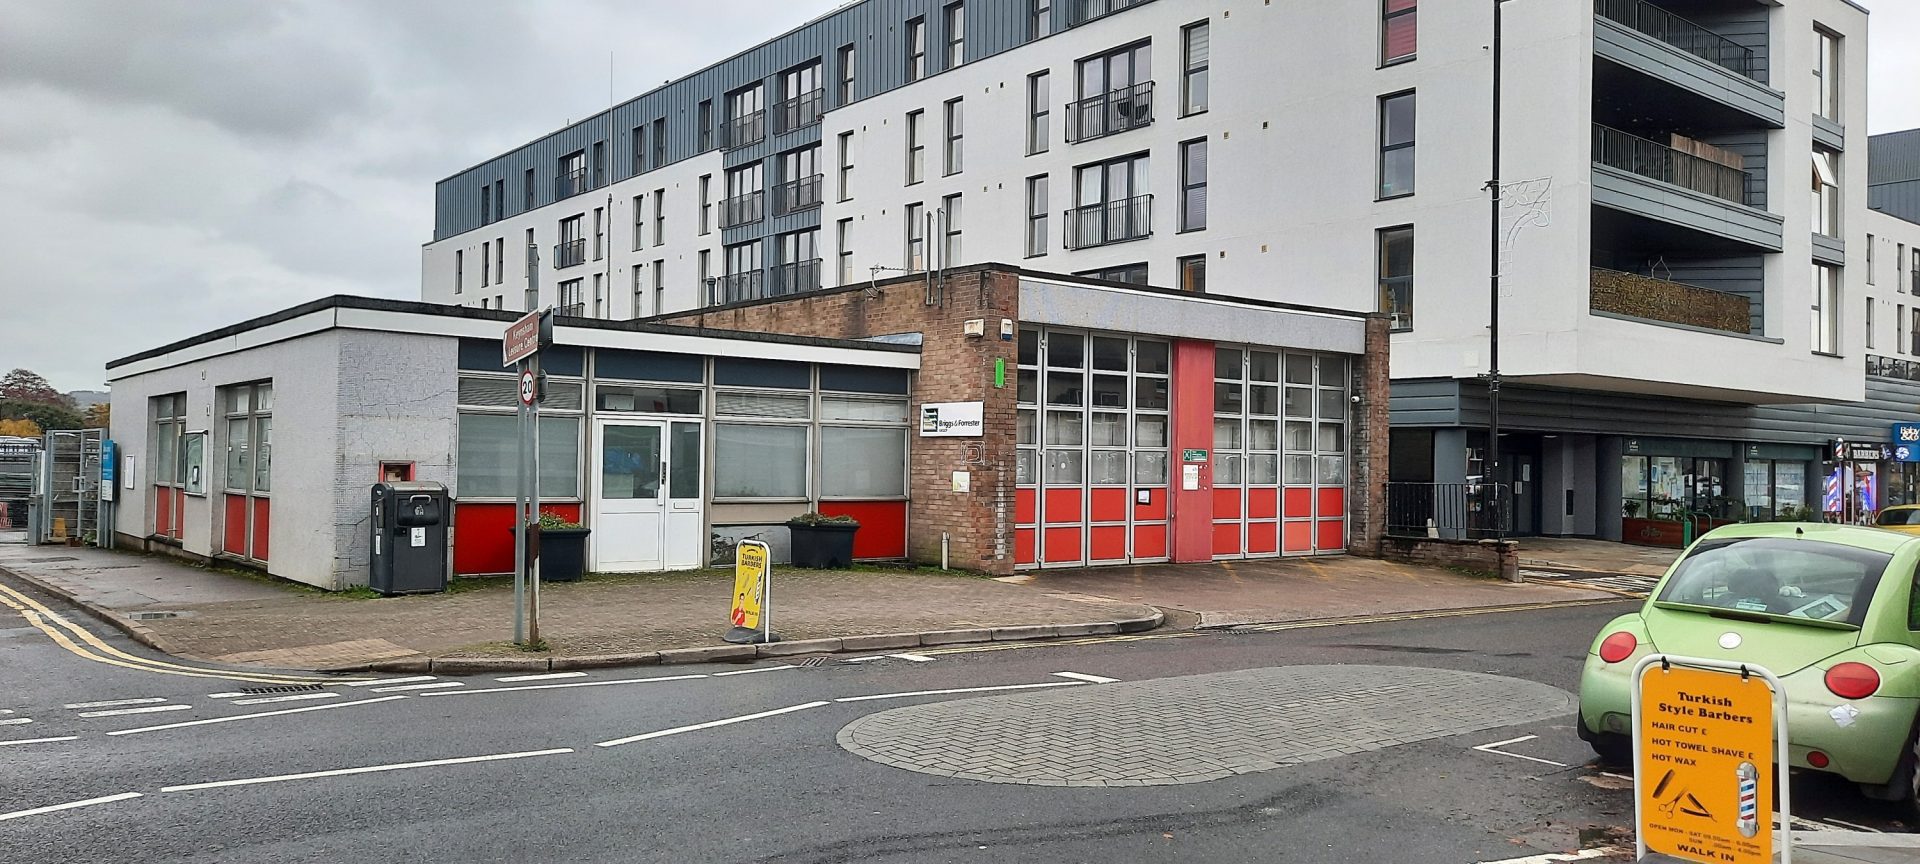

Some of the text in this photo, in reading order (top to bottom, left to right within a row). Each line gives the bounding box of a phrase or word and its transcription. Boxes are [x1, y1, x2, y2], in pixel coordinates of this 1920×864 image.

[508, 342, 523, 357] Leisure
[522, 380, 532, 394] 20
[939, 419, 953, 428] Briggs
[958, 419, 980, 427] Forrester
[1900, 426, 1920, 435] Baby
[742, 553, 762, 562] TURKISH
[741, 560, 761, 569] BARBERS
[1678, 691, 1732, 707] Turkish
[1659, 702, 1753, 724] Style Barbers
[1652, 721, 1675, 731] HAIR
[1678, 725, 1698, 734] CUT
[1652, 737, 1671, 746] HOT
[1675, 741, 1708, 753] TOWEL
[1711, 746, 1745, 759] SHAVE
[1652, 753, 1697, 766] HOT WAX
[1649, 823, 1667, 831] OPEN
[1677, 843, 1716, 858] WALK
[1720, 852, 1735, 862] IN
